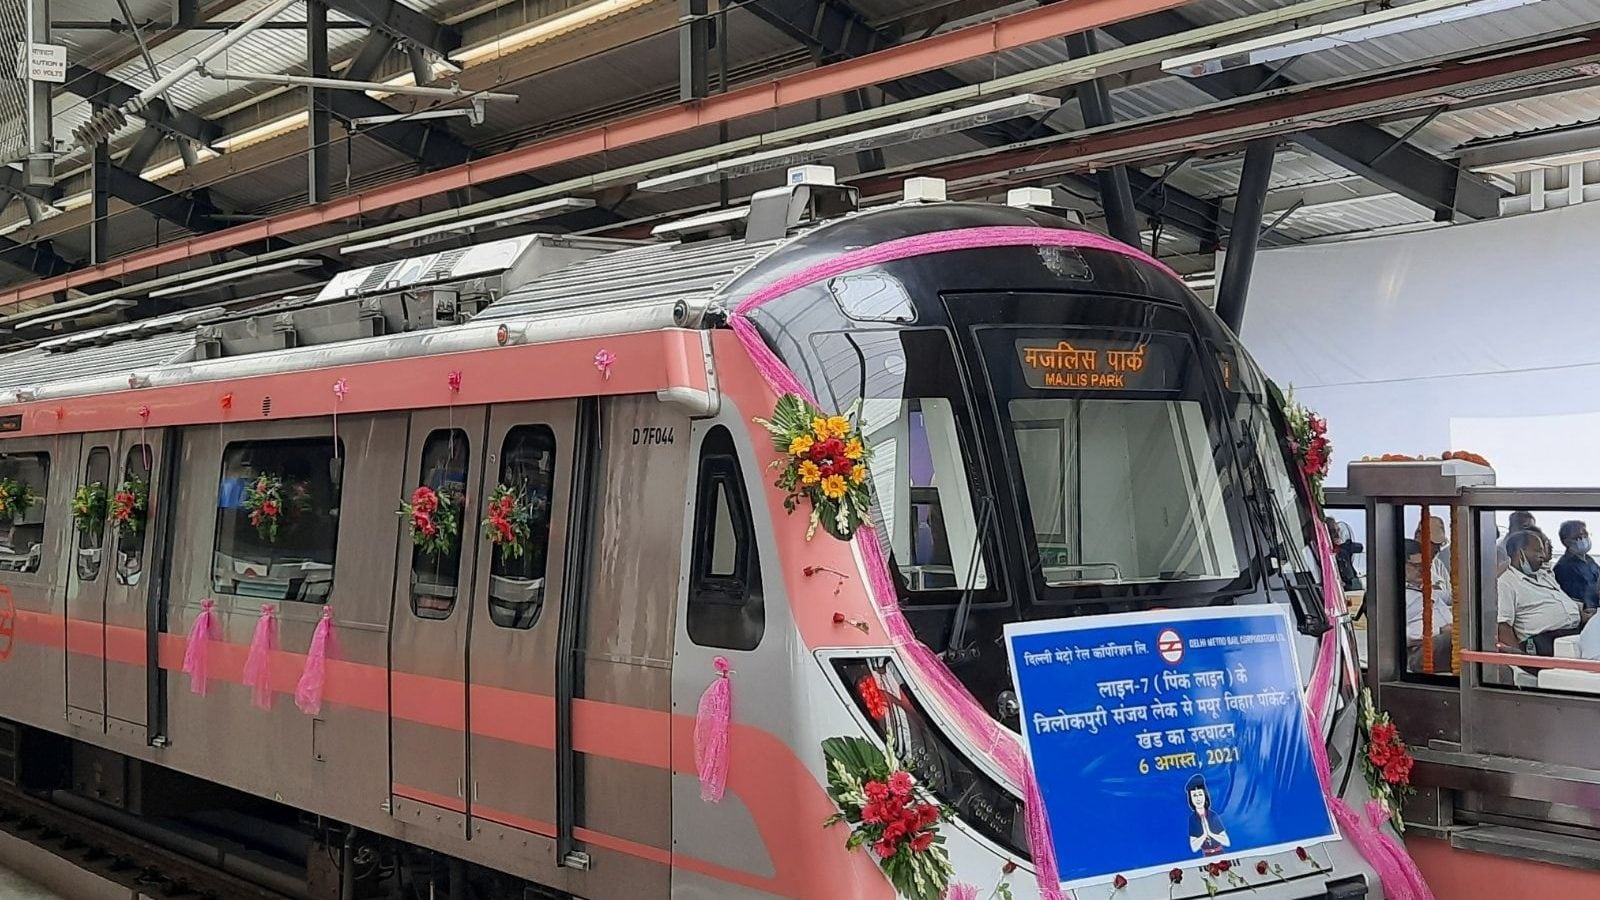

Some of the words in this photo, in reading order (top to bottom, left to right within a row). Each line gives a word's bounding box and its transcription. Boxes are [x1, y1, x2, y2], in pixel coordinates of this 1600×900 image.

[1024, 341, 1096, 370] मजलिस
[1106, 344, 1146, 371] पार्क
[1045, 373, 1088, 387] MAJLIS
[1091, 374, 1124, 387] PARK
[1189, 638, 1206, 648] DELHI
[1024, 649, 1053, 666] दिल्ली
[1075, 646, 1090, 660] रेल
[1163, 669, 1191, 691] पिंक
[1193, 670, 1225, 689] लाइन
[1234, 662, 1248, 683] के
[1033, 704, 1108, 734] त्रिलोकपुरी
[1111, 703, 1148, 725] संजय
[1150, 697, 1178, 719] लेक
[1180, 695, 1194, 716] से
[1195, 698, 1222, 718] मयूर
[1224, 691, 1255, 712] विहार
[1136, 728, 1164, 749] खंड
[1165, 729, 1186, 745] का
[1139, 758, 1150, 774] 6
[1205, 746, 1240, 765] 2021
